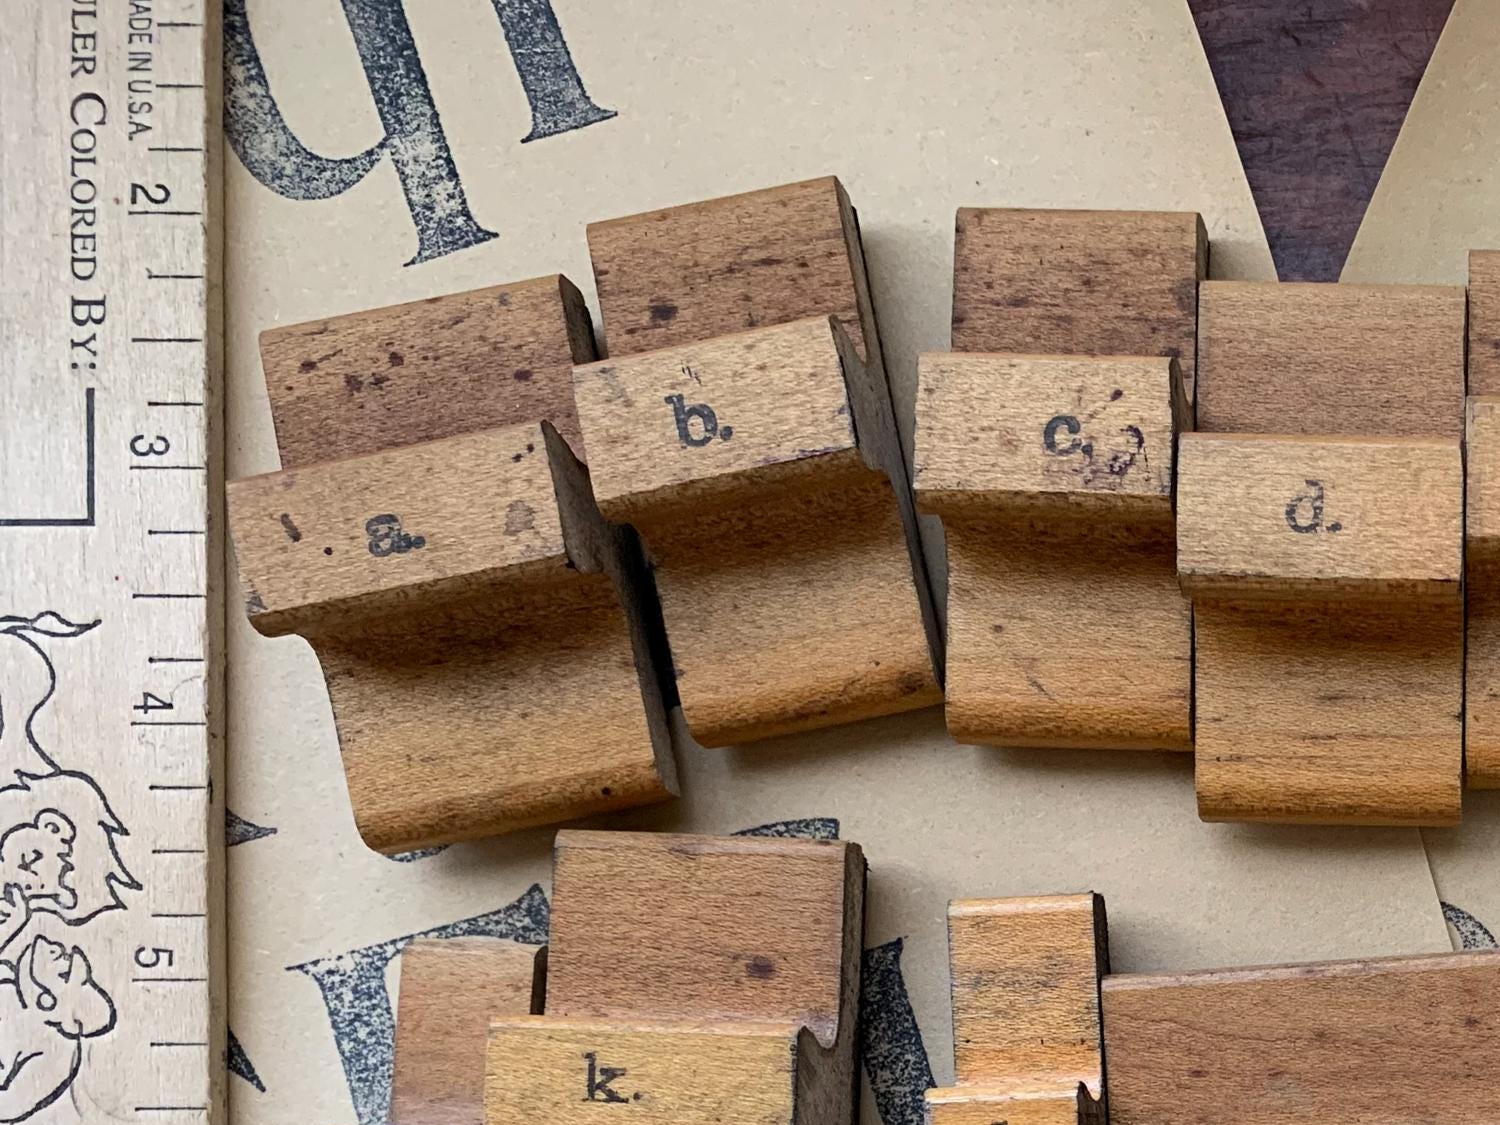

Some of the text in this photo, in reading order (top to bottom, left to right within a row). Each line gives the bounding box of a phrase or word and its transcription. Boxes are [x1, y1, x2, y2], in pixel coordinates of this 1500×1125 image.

[128, 0, 153, 141] ADE IN U.S.A.
[70, 92, 107, 281] COLORED
[130, 182, 171, 205] 2
[70, 294, 107, 370] BY:
[130, 435, 170, 457] 3
[663, 394, 734, 447] b.
[133, 691, 174, 715] 4
[134, 946, 174, 968] 5
[581, 1051, 642, 1103] k.
